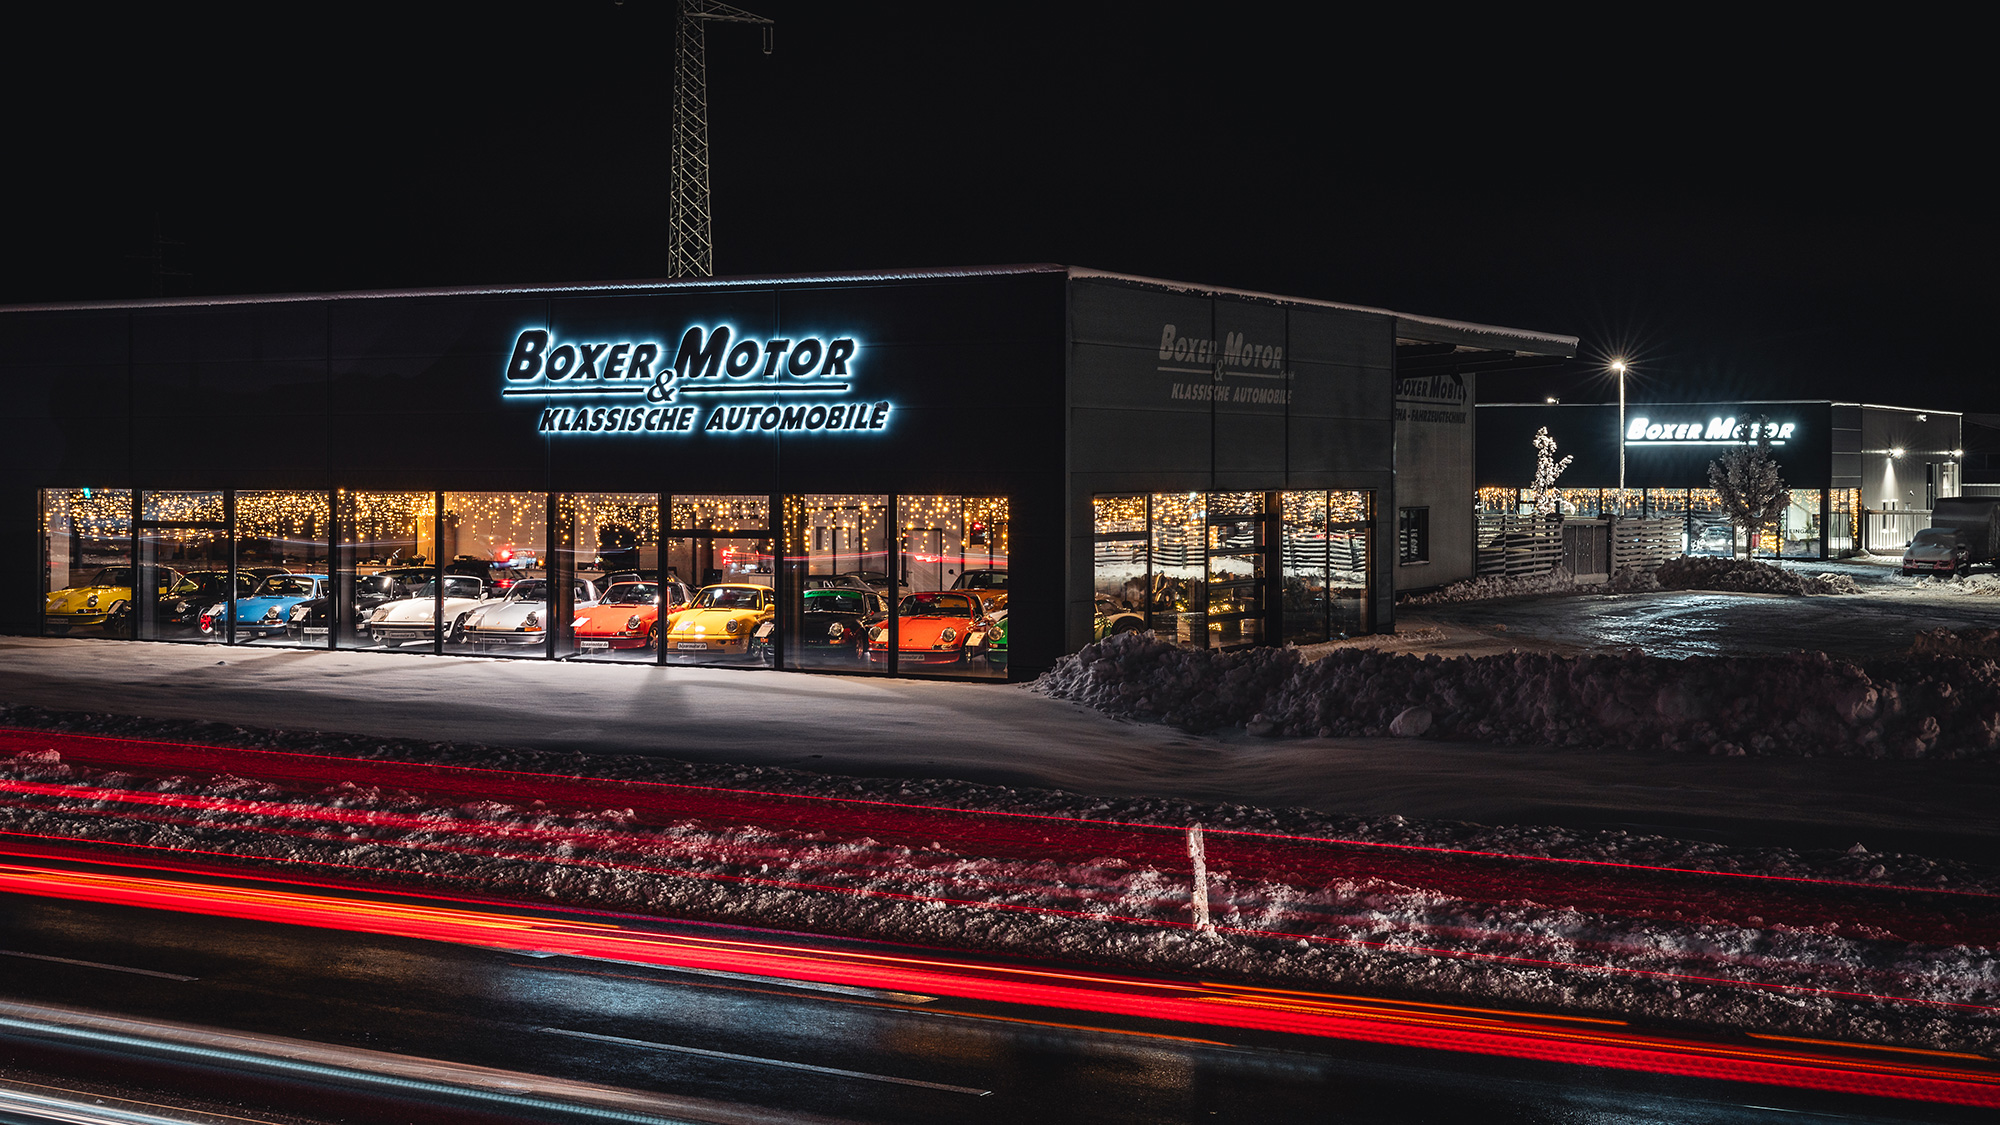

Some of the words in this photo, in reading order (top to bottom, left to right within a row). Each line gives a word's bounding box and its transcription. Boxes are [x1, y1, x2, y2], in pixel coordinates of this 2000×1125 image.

[506, 329, 659, 381] BOXER
[673, 325, 855, 379] MOTOR
[1158, 323, 1218, 364] BOXER
[1223, 331, 1283, 369] MOTOR
[1214, 359, 1224, 381] &
[646, 369, 677, 402] &
[1171, 383, 1231, 402] KLASSISCHE
[1233, 387, 1293, 405] AUTOMOBILE
[538, 407, 694, 431] KLASSISCHE
[705, 401, 889, 431] AUTOMOBILE
[1626, 417, 1703, 440] BOXER
